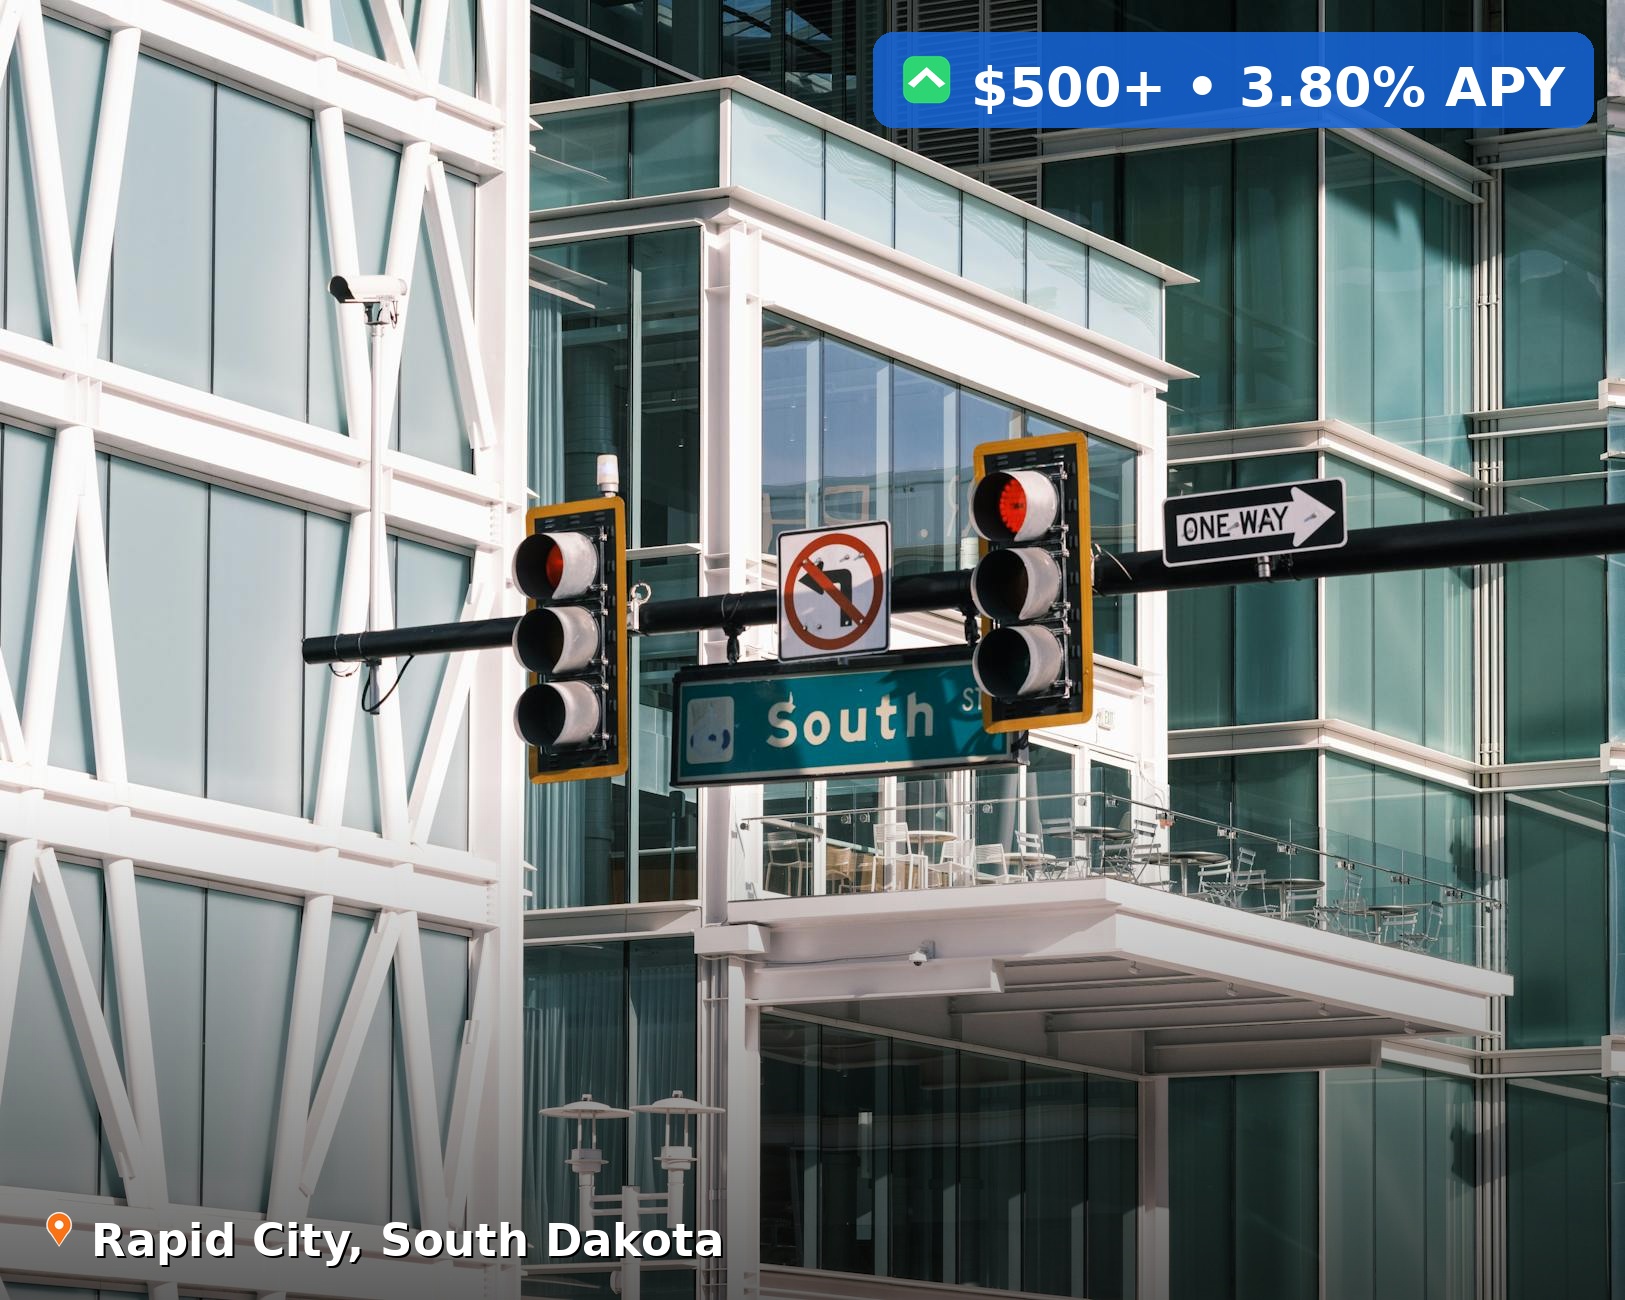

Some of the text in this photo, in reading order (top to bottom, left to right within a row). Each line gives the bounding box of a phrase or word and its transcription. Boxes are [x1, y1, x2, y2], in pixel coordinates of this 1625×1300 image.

[1183, 506, 1288, 542] ONE WAY
[766, 692, 934, 748] South
